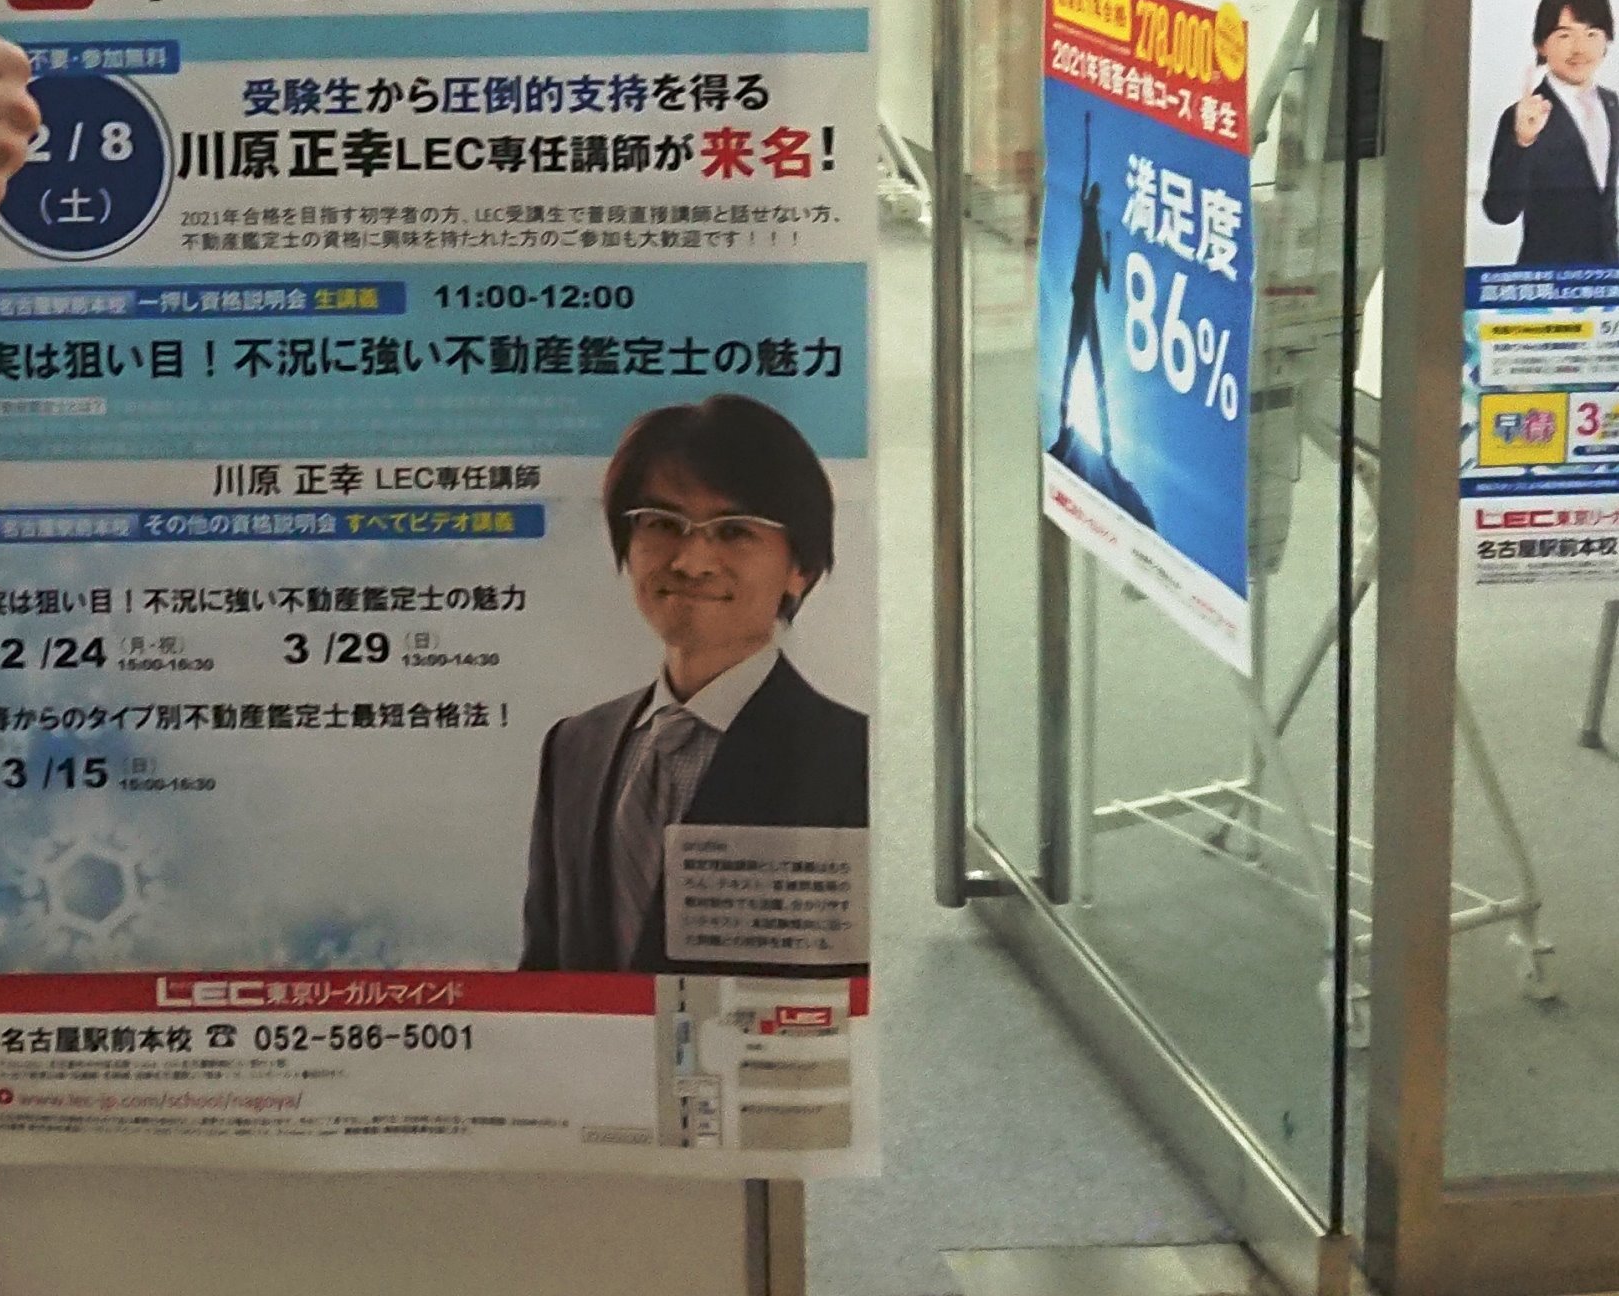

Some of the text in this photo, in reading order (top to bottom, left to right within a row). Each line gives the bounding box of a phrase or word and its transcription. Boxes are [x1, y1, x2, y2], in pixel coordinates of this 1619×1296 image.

[242, 73, 773, 117] 受験生から圧倒的支持を得る
[176, 125, 837, 182] 川原正幸LEC専任講師が来名！
[39, 188, 113, 225] (土)
[1121, 153, 1243, 283] 満足度
[434, 283, 636, 310] 11:00-12:00
[1124, 251, 1239, 422] 86%
[212, 462, 542, 497] 川原 正幸 LEC専任講師
[155, 976, 463, 1007] LEC東京リーガルマインド
[0, 1022, 474, 1053] 名古屋駅前本校 052-586-5001
